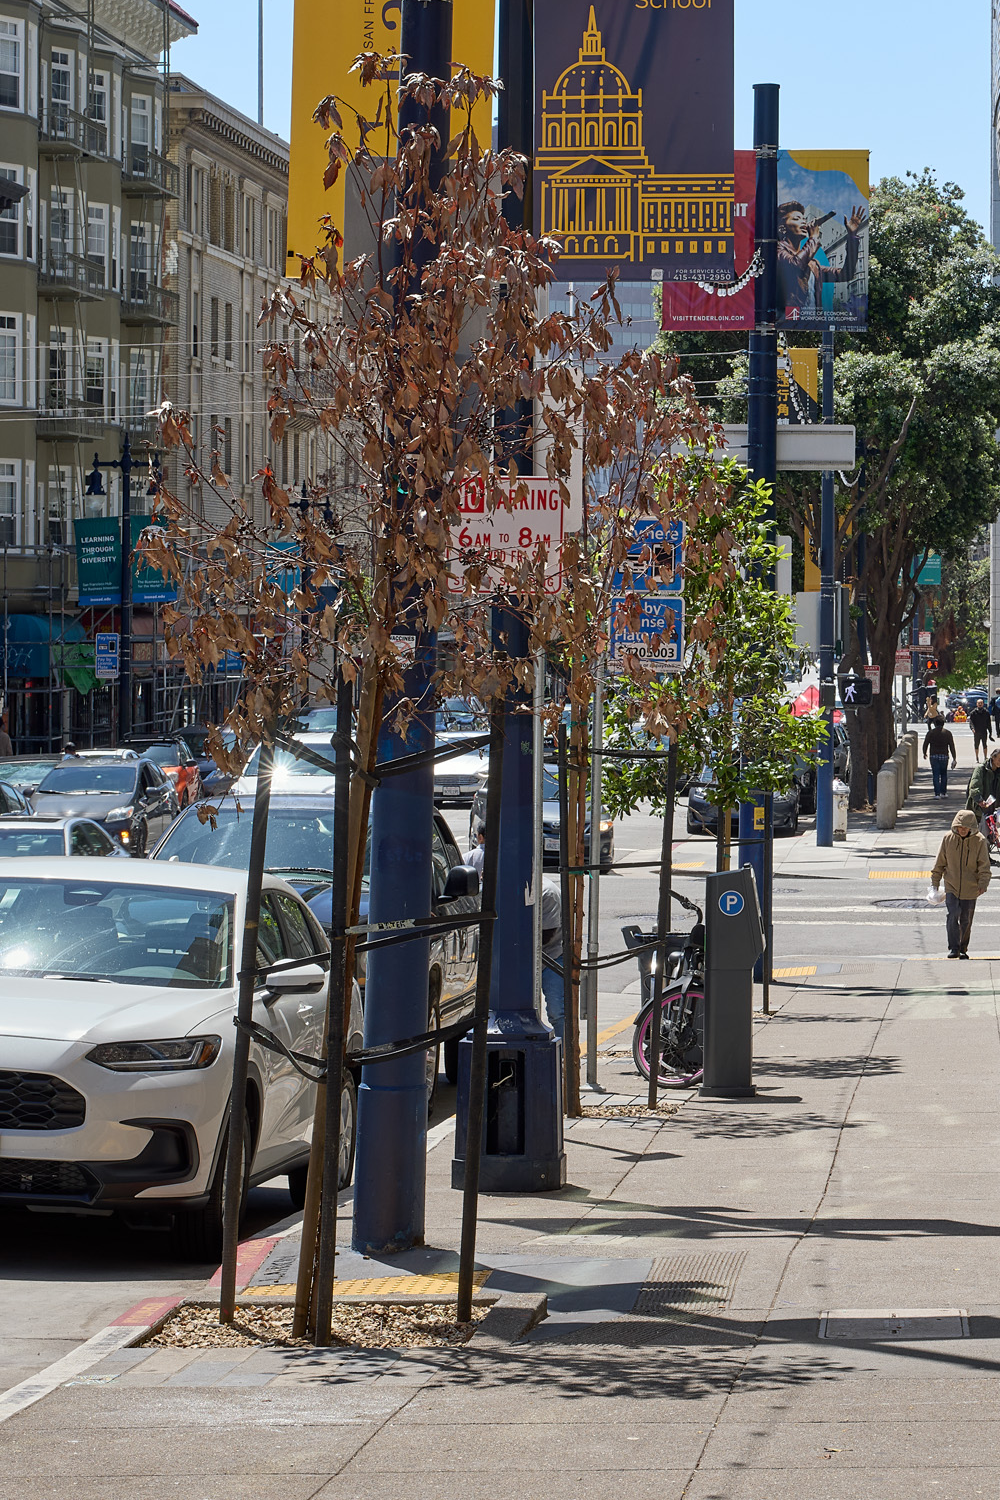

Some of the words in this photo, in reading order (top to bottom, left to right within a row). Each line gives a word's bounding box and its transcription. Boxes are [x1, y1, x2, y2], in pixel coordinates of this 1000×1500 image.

[363, 20, 375, 49] SAN
[490, 489, 559, 510] ARKING
[80, 536, 114, 544] LEARNING
[499, 533, 510, 542] TO
[644, 602, 662, 616] by
[726, 895, 738, 911] P
